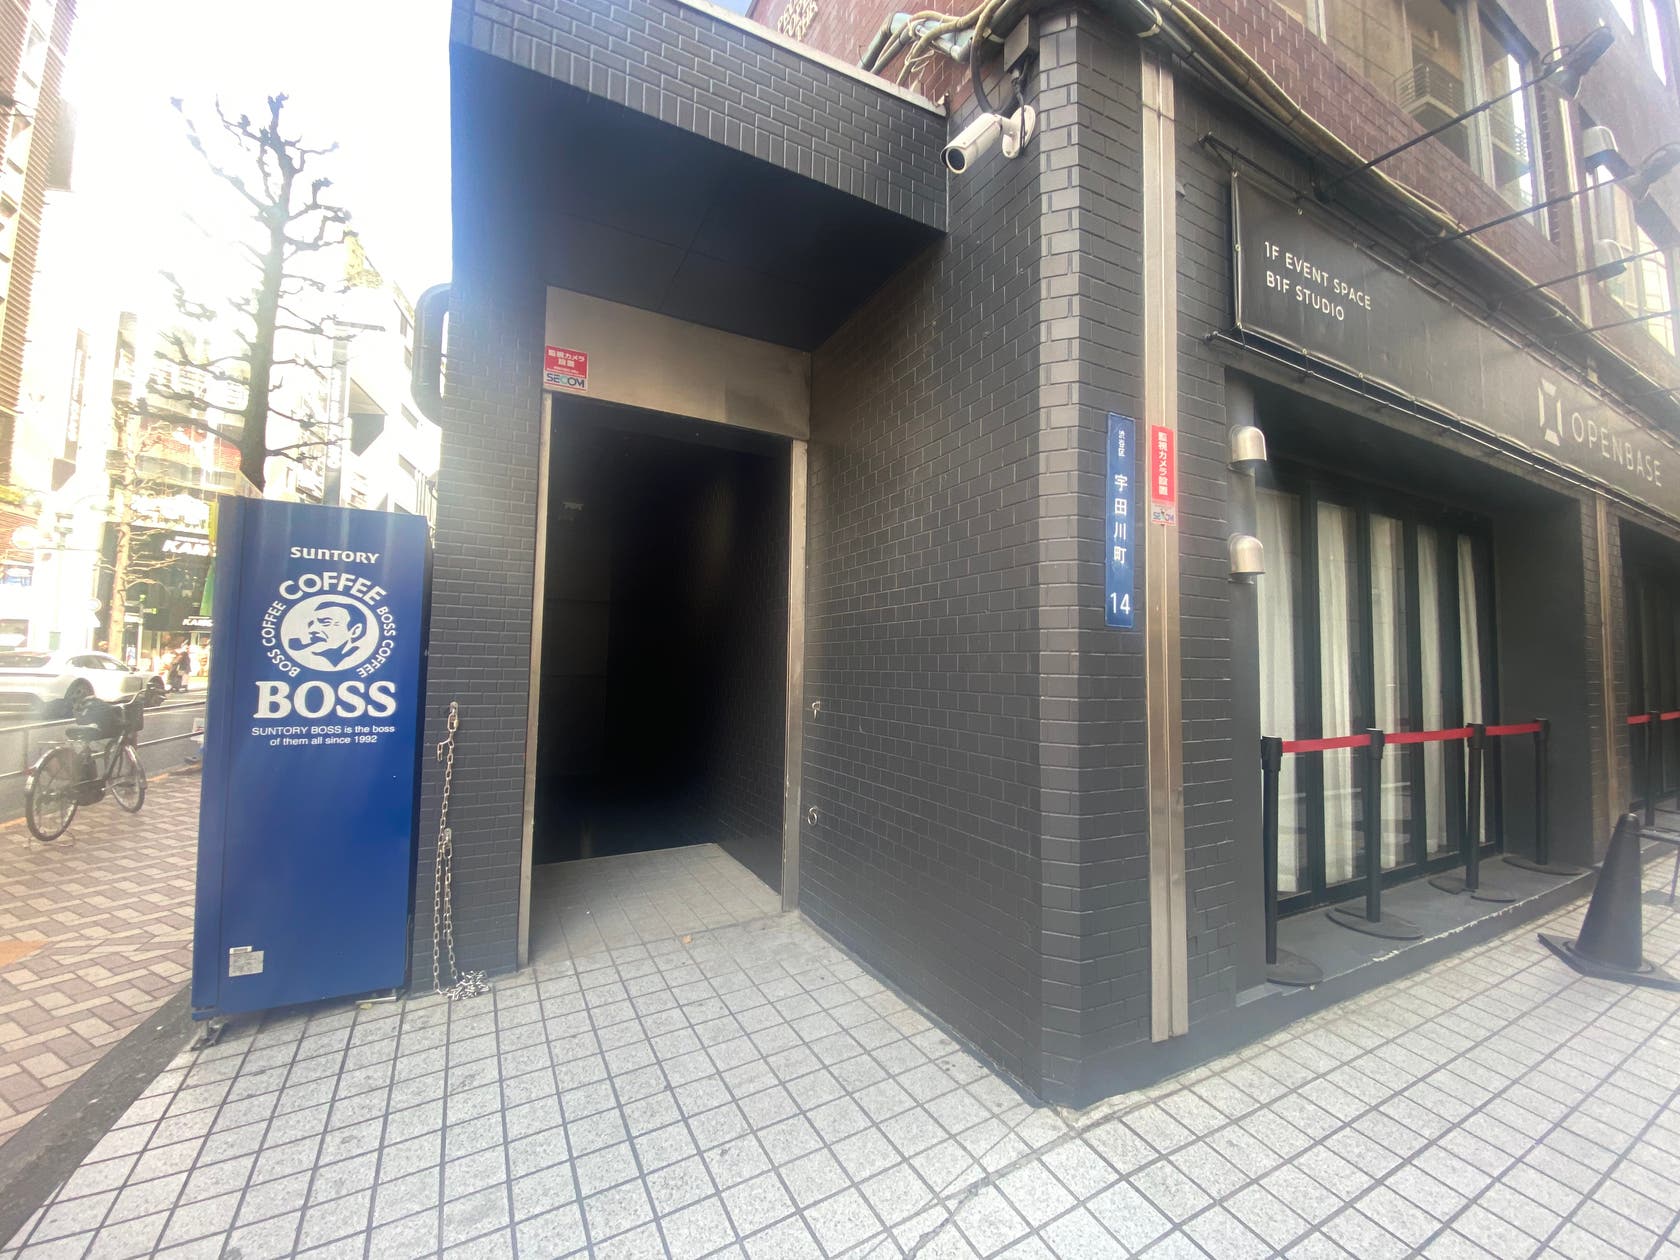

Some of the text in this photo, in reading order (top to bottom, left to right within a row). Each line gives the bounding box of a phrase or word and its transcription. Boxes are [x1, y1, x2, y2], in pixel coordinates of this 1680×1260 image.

[1264, 241, 1372, 310] 1F EVENT SPACE
[1266, 270, 1345, 321] B1F STUDIO
[546, 373, 585, 388] SECOM
[1571, 411, 1662, 487] OPENBASE
[1113, 473, 1128, 564] 宇田川町
[279, 571, 387, 606] COFFEE
[1109, 592, 1131, 615] 14
[261, 600, 301, 678] BOSS COFFEE
[356, 605, 396, 678] BOSS COFFEE
[253, 680, 397, 719] BOSS
[251, 725, 395, 736] SUNTORY BOSS is the boss
[270, 735, 377, 746] of them all since 1992
